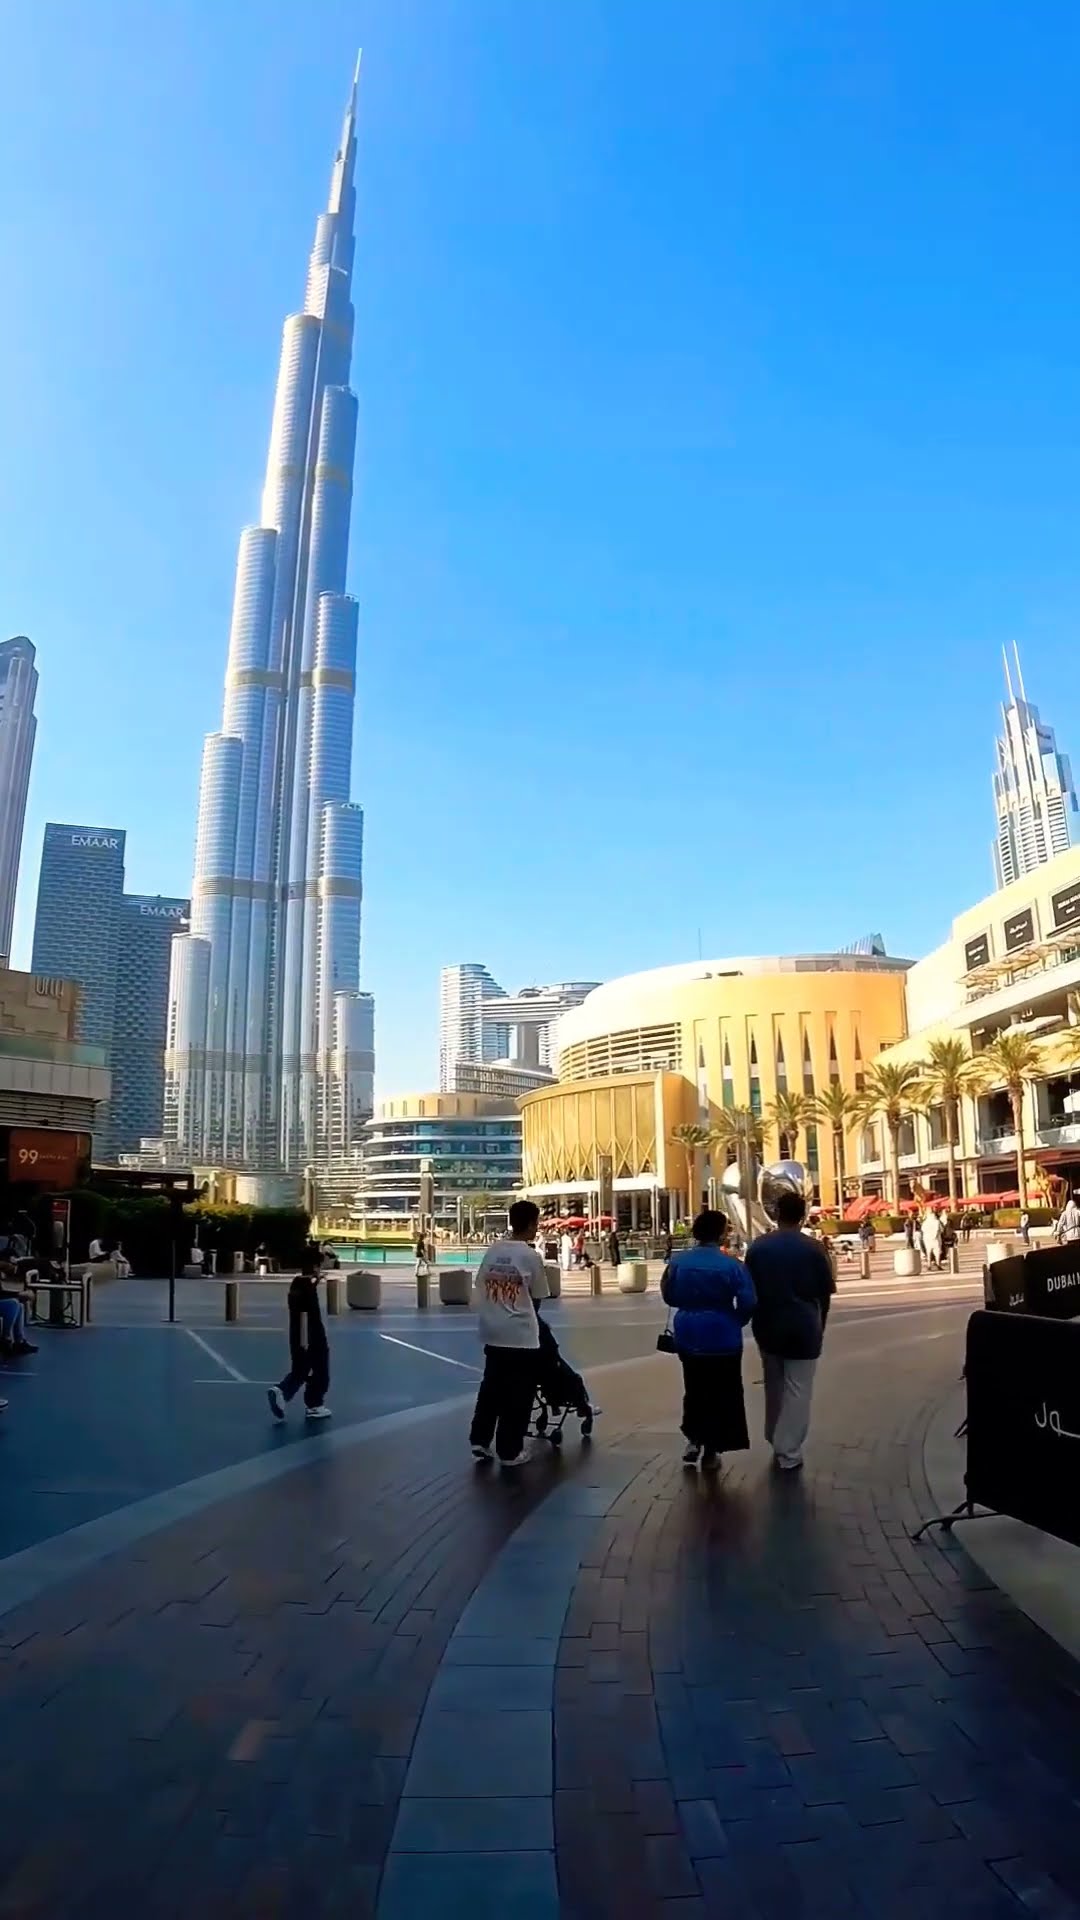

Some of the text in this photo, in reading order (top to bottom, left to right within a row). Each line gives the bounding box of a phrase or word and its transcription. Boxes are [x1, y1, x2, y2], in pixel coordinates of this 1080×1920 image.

[71, 834, 118, 849] EMAAR
[140, 904, 184, 918] EMAAR
[19, 1148, 39, 1164] 99
[1047, 1272, 1076, 1292] DUBAI
